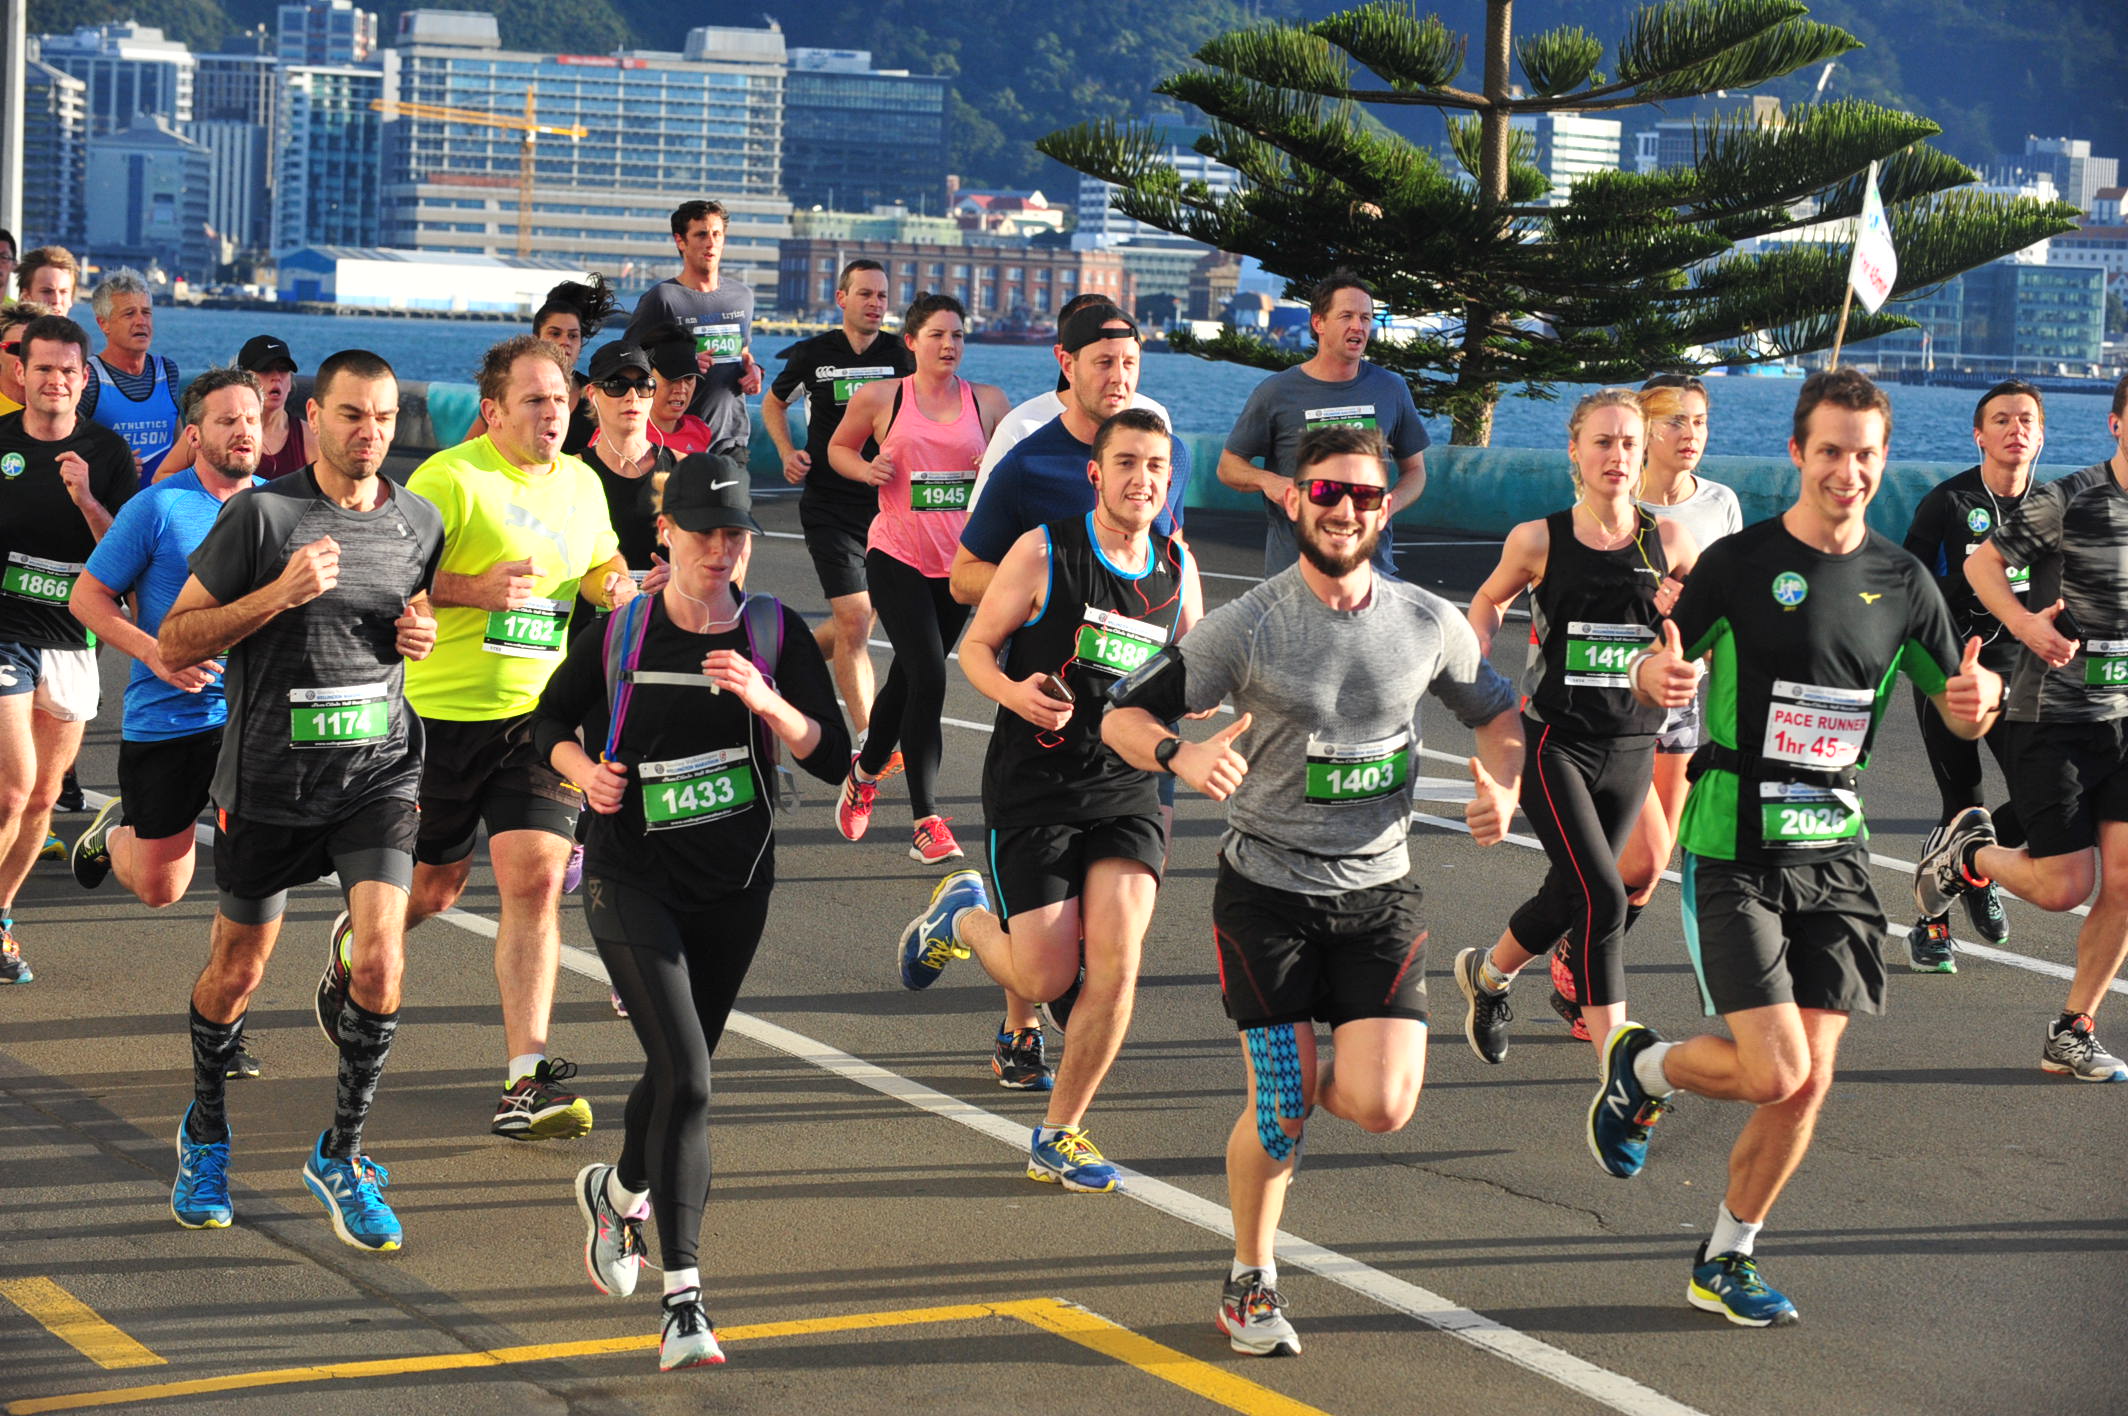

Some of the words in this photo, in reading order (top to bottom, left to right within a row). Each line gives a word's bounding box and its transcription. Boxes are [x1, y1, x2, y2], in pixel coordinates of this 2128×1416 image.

[704, 338, 735, 352] 1640
[112, 420, 168, 430] ATHLETICS
[123, 431, 168, 446] ELSON
[923, 487, 965, 504] 1945
[18, 573, 69, 598] 1866
[504, 616, 555, 641] 1782
[2102, 661, 2128, 681] 15
[312, 709, 372, 736] 1174
[1774, 710, 1814, 728] PACE
[1817, 716, 1867, 732] RUNNER
[1775, 730, 1806, 754] 1hr
[1326, 763, 1394, 793] 1403
[662, 776, 735, 814] 1433
[1780, 808, 1847, 835] 2026
